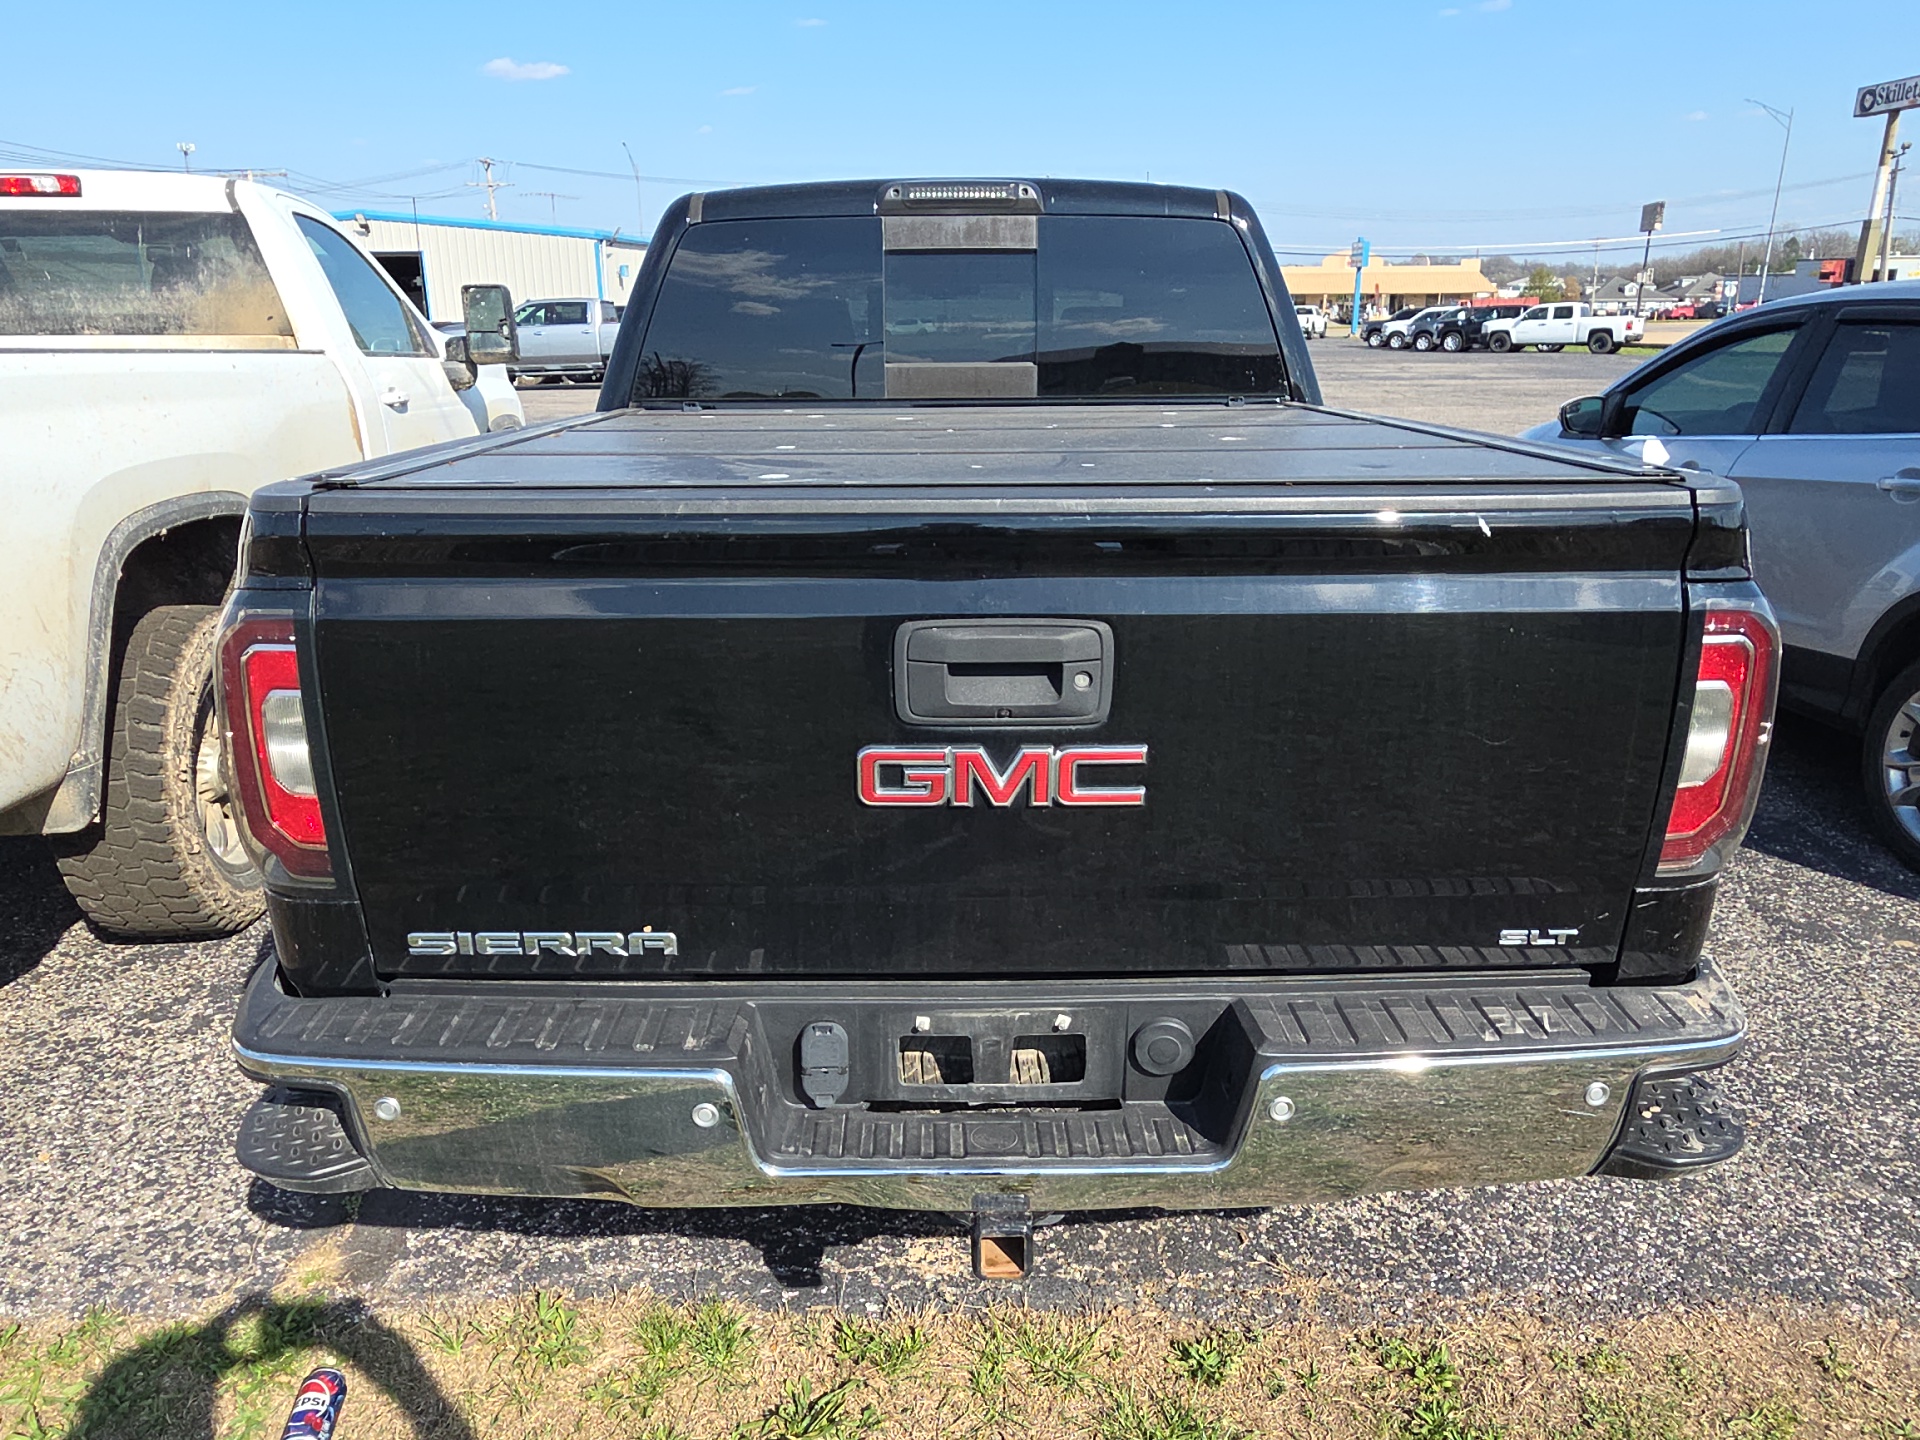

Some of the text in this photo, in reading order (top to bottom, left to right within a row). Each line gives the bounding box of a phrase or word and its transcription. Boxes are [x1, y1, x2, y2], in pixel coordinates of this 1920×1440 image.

[857, 744, 1149, 808] GMC
[407, 931, 678, 956] SIERRA
[1499, 928, 1579, 946] SLT
[297, 1397, 326, 1407] PSI
